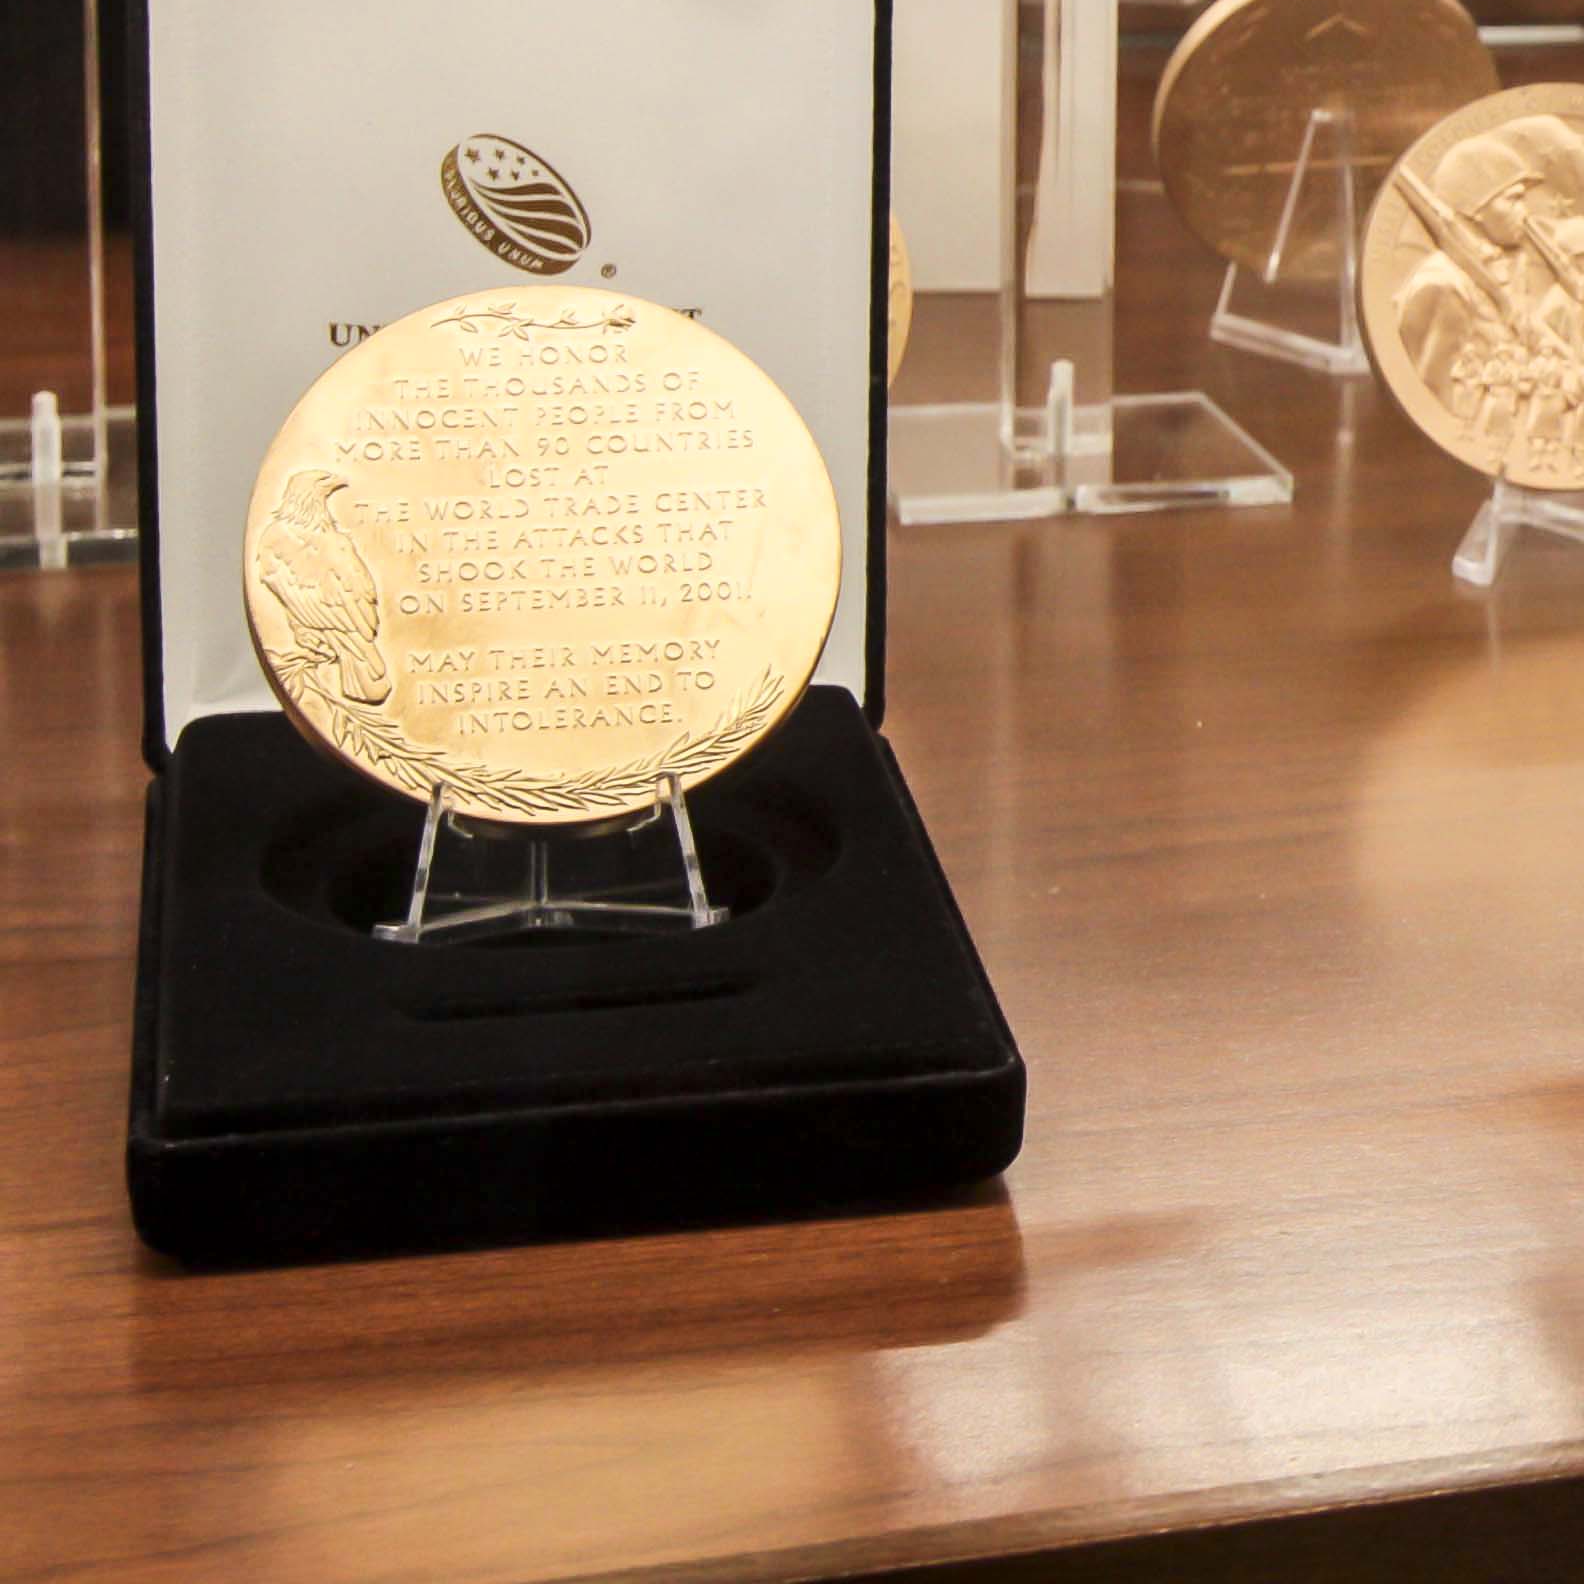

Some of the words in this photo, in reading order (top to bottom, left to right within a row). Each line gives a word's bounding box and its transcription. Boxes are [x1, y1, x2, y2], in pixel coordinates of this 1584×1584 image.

[458, 346, 501, 368] WE
[518, 344, 629, 369] HONOR
[394, 377, 450, 401] THE
[463, 371, 647, 400] THOUSANDS
[664, 370, 702, 392] OF
[354, 406, 520, 432] INNOCENT
[533, 402, 640, 427] PEOPLE
[655, 399, 735, 423] FROM
[335, 438, 422, 463] MORE
[434, 436, 520, 460] THAN
[537, 434, 571, 457] 90
[586, 428, 755, 455] COUNTRIES
[486, 465, 559, 490] LOST
[573, 464, 610, 487] AT
[353, 500, 409, 524] THE
[423, 496, 530, 521] WORLD
[543, 493, 641, 517] TRADE
[655, 487, 768, 514] CENTER
[397, 532, 429, 555] IN
[443, 528, 499, 552] THE
[512, 523, 645, 550] ATTACKS
[657, 519, 735, 544] THAT
[418, 558, 527, 584] SHOOK
[539, 555, 595, 578] THE
[608, 552, 714, 576] WORLD
[399, 590, 448, 616] ON
[461, 585, 624, 613] SEPTEMBER
[639, 584, 669, 608] 11,
[680, 580, 753, 604] 2001.
[407, 650, 475, 675] MAY
[487, 645, 577, 671] THEIR
[591, 638, 722, 667] MEMORY
[417, 680, 530, 706] INSPIRE
[544, 676, 589, 700] AN
[607, 672, 663, 697] END
[678, 669, 716, 693] TO
[456, 703, 683, 735] INTOLERANCE.
